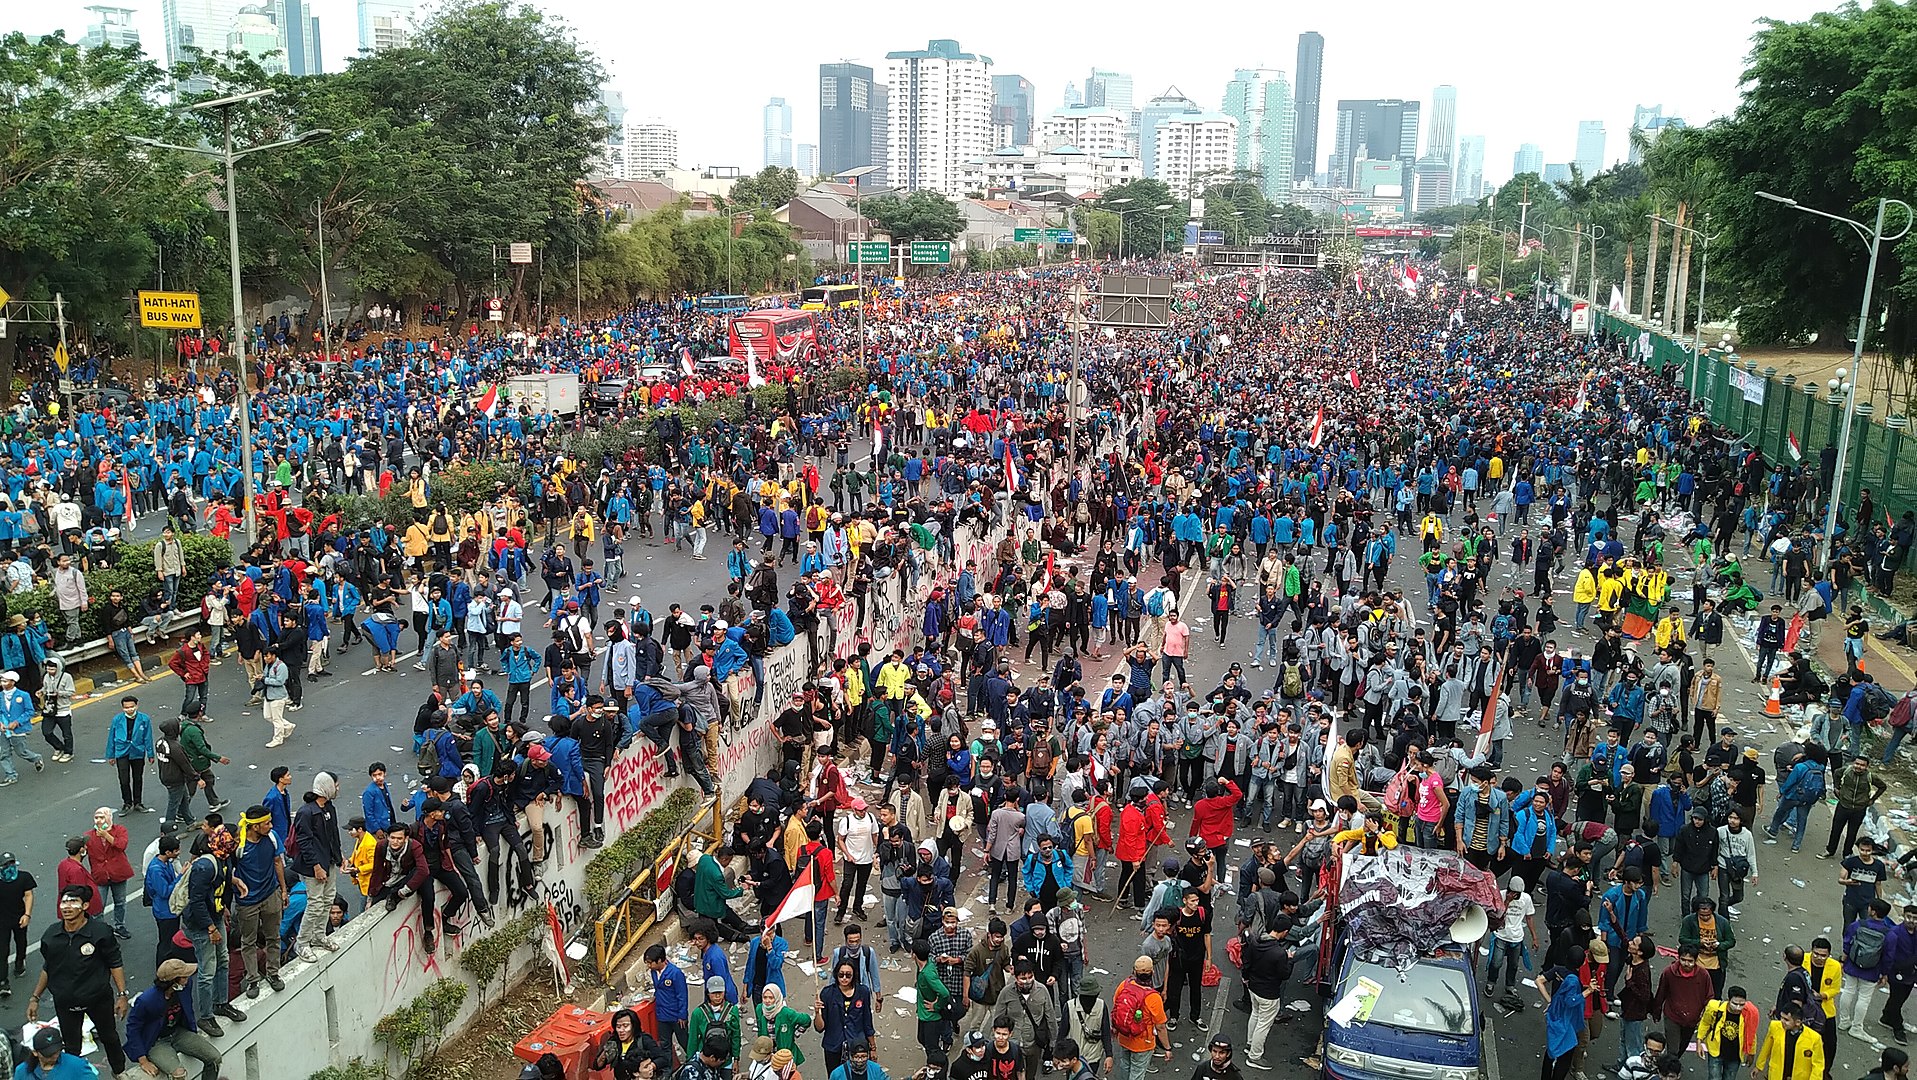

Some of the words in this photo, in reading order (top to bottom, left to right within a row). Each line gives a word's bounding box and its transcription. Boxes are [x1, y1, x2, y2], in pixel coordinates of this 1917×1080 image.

[144, 298, 195, 308] HATI-HATI
[147, 312, 168, 321] BUS
[171, 313, 194, 322] WAY
[611, 744, 657, 788] DEWAN
